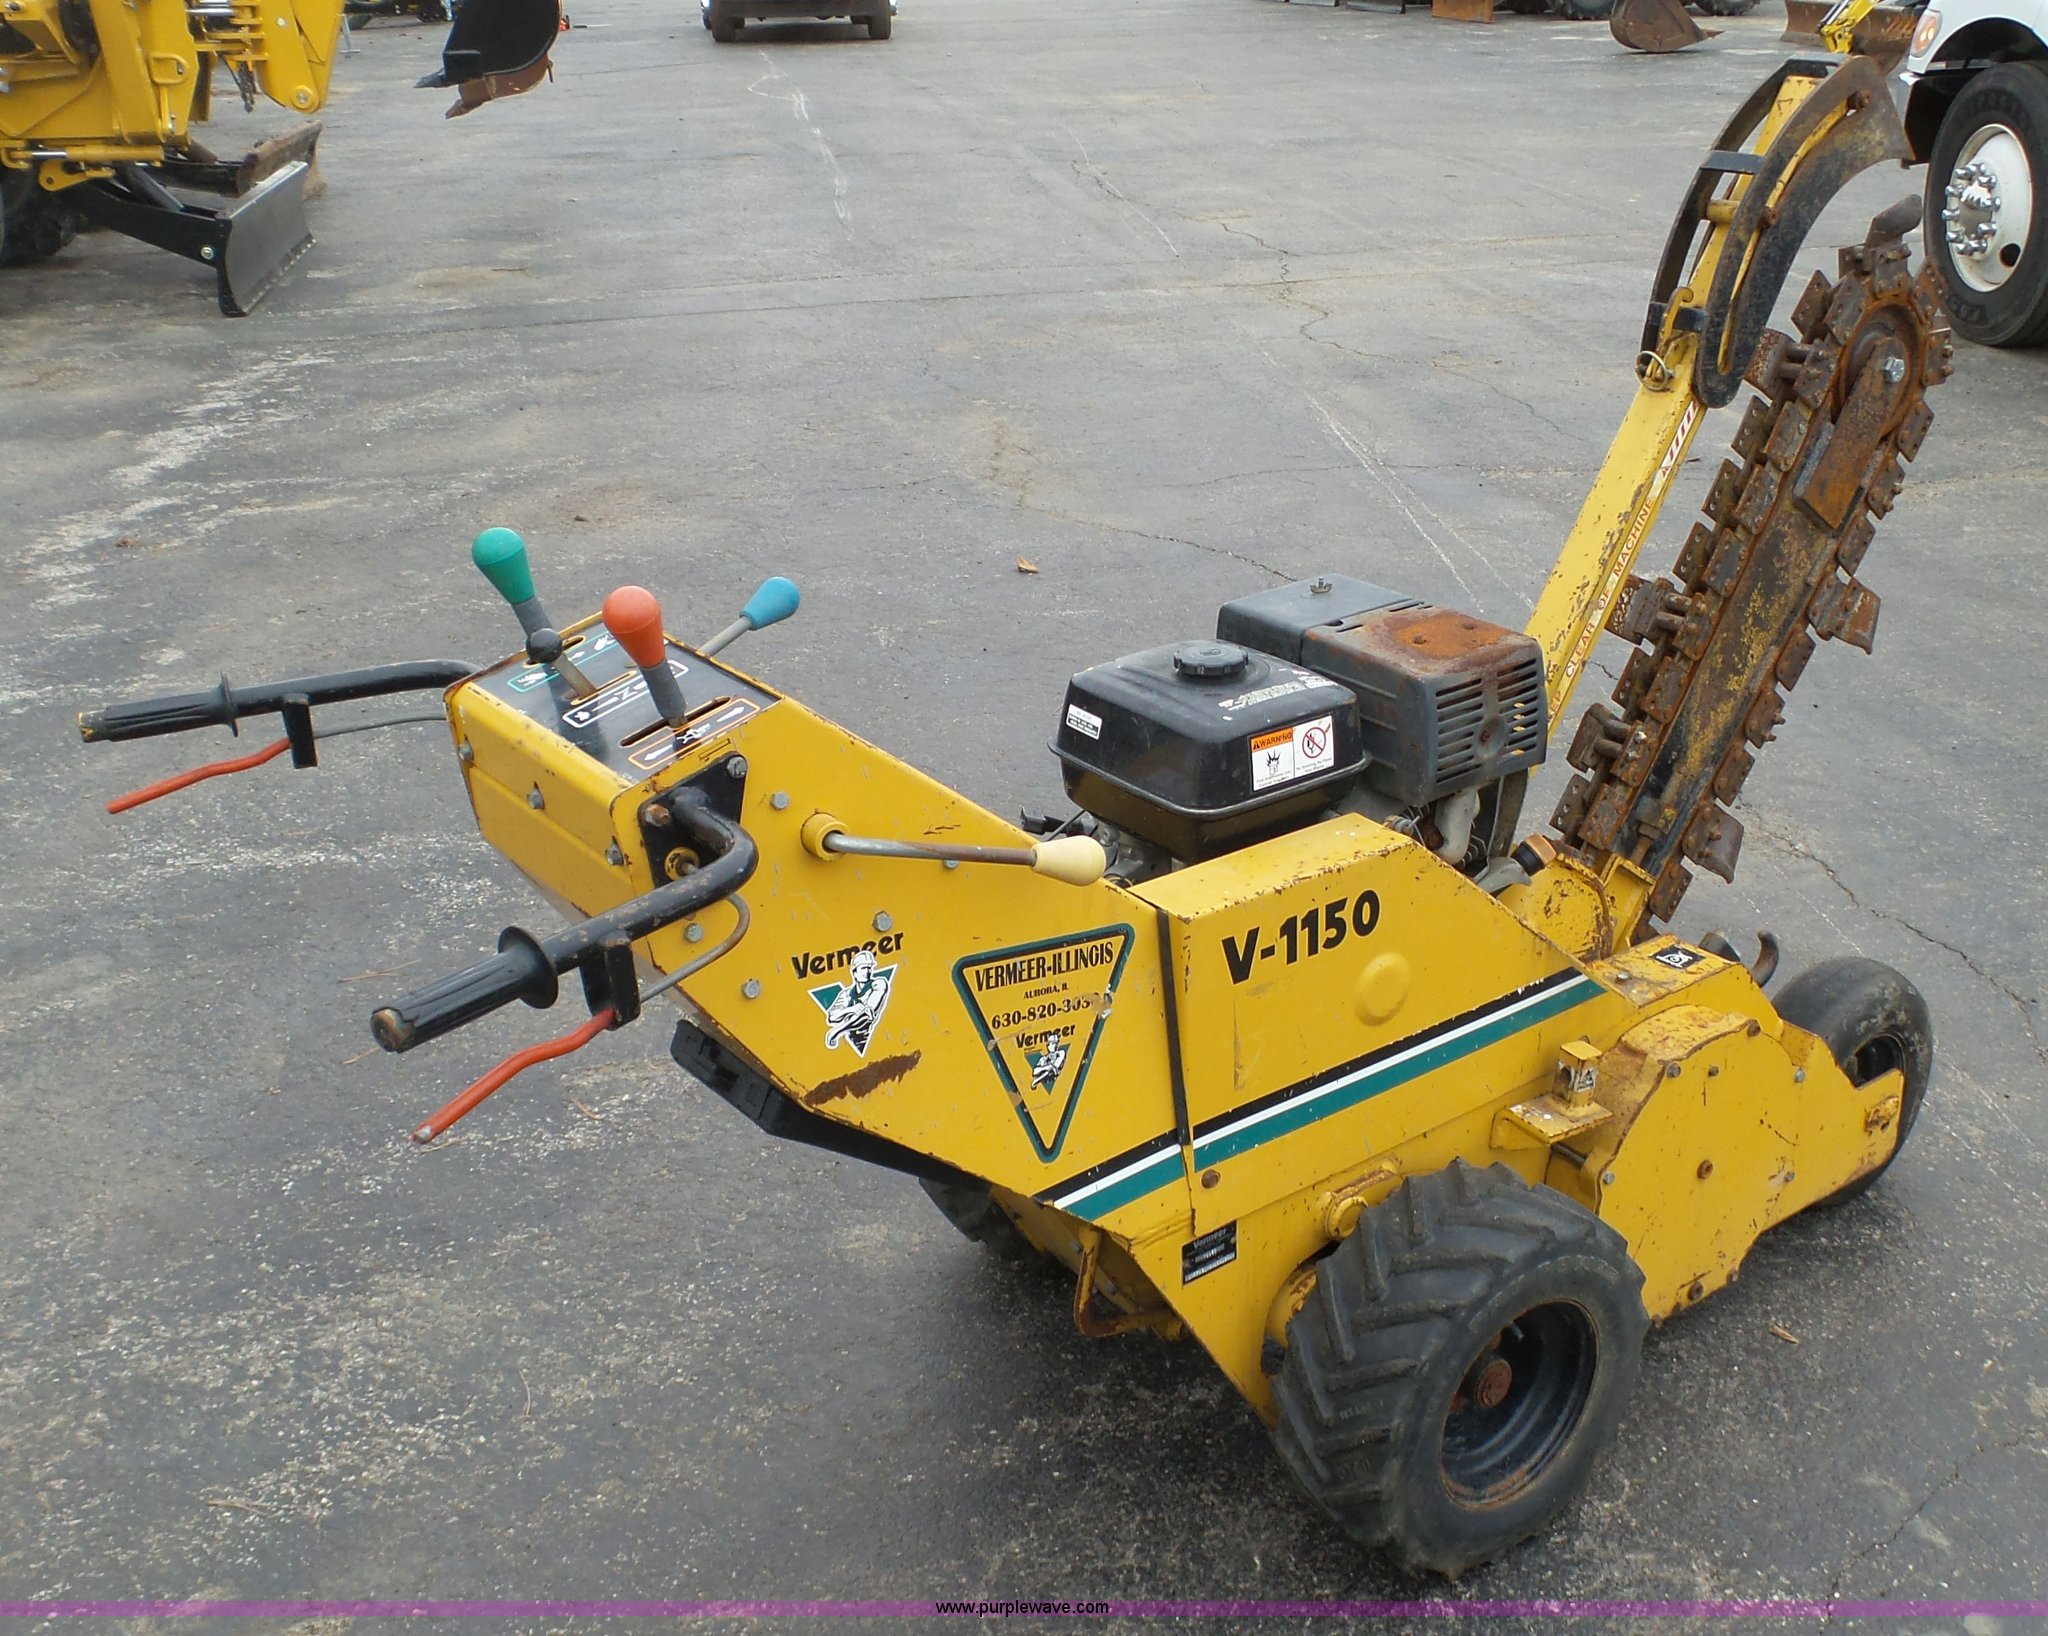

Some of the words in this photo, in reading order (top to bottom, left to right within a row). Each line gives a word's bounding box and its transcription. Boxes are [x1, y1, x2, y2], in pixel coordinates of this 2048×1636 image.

[1566, 622, 1595, 679] CLEAR
[1598, 589, 1612, 611] OF
[1613, 499, 1654, 577] MACHINE
[1259, 732, 1292, 748] WARNING
[1221, 889, 1380, 985] V-1150
[791, 932, 904, 980] Vermeer
[1023, 985, 1060, 1000] AURORA,
[1061, 982, 1069, 992] IL
[1016, 1024, 1076, 1049] Vermeer
